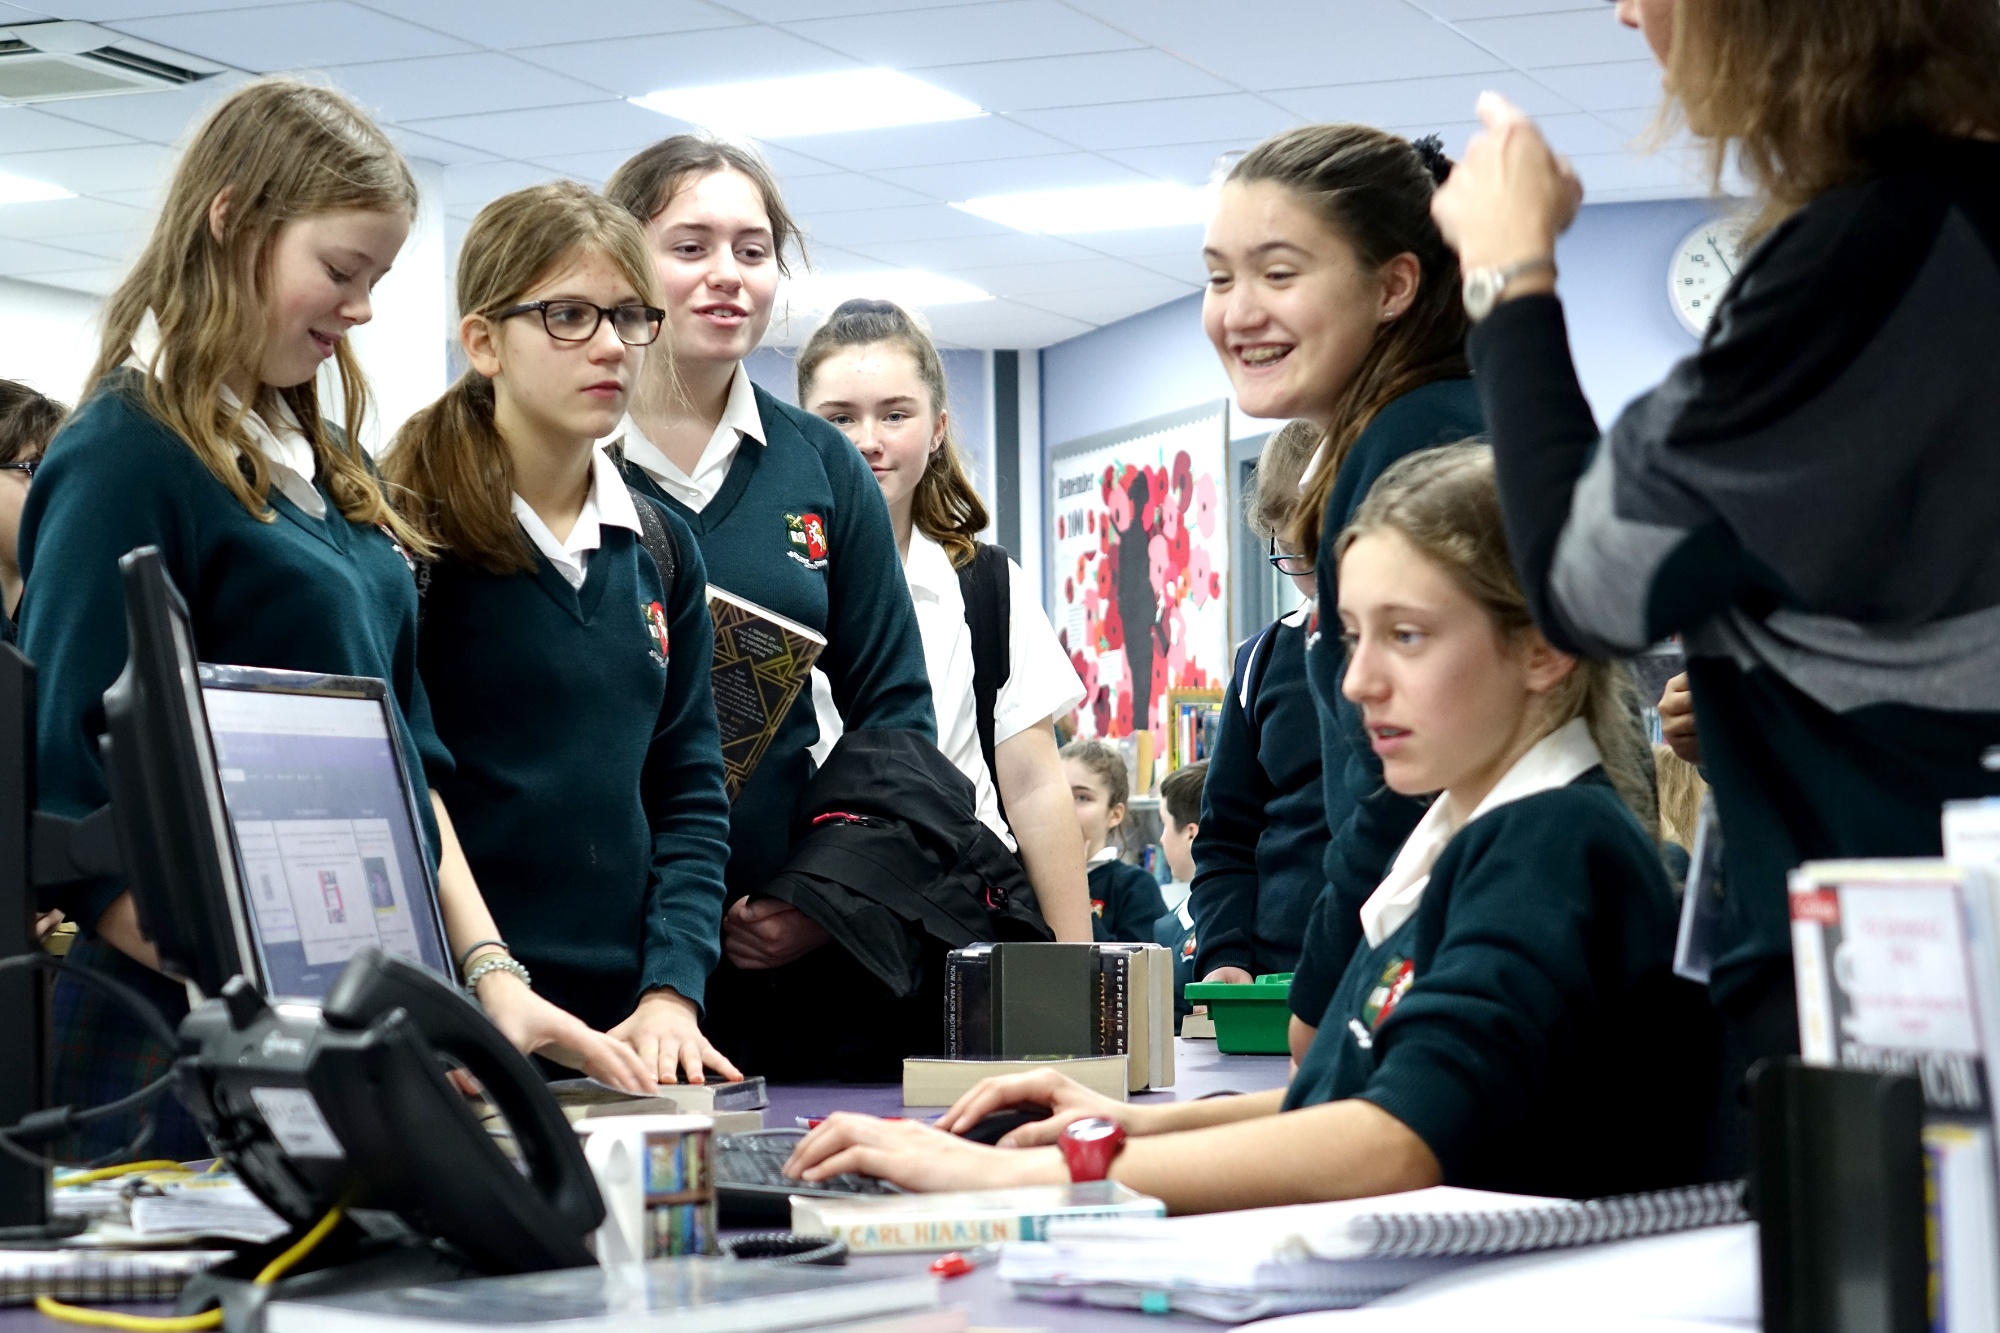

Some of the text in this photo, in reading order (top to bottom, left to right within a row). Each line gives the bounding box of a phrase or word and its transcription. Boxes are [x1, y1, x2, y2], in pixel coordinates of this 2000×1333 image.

[1059, 473, 1094, 499] Remember
[1068, 508, 1084, 538] 100
[1116, 958, 1124, 1032] STEPHENIE
[850, 1223, 907, 1248] CARL
[914, 1219, 1007, 1244] HIAASEN
